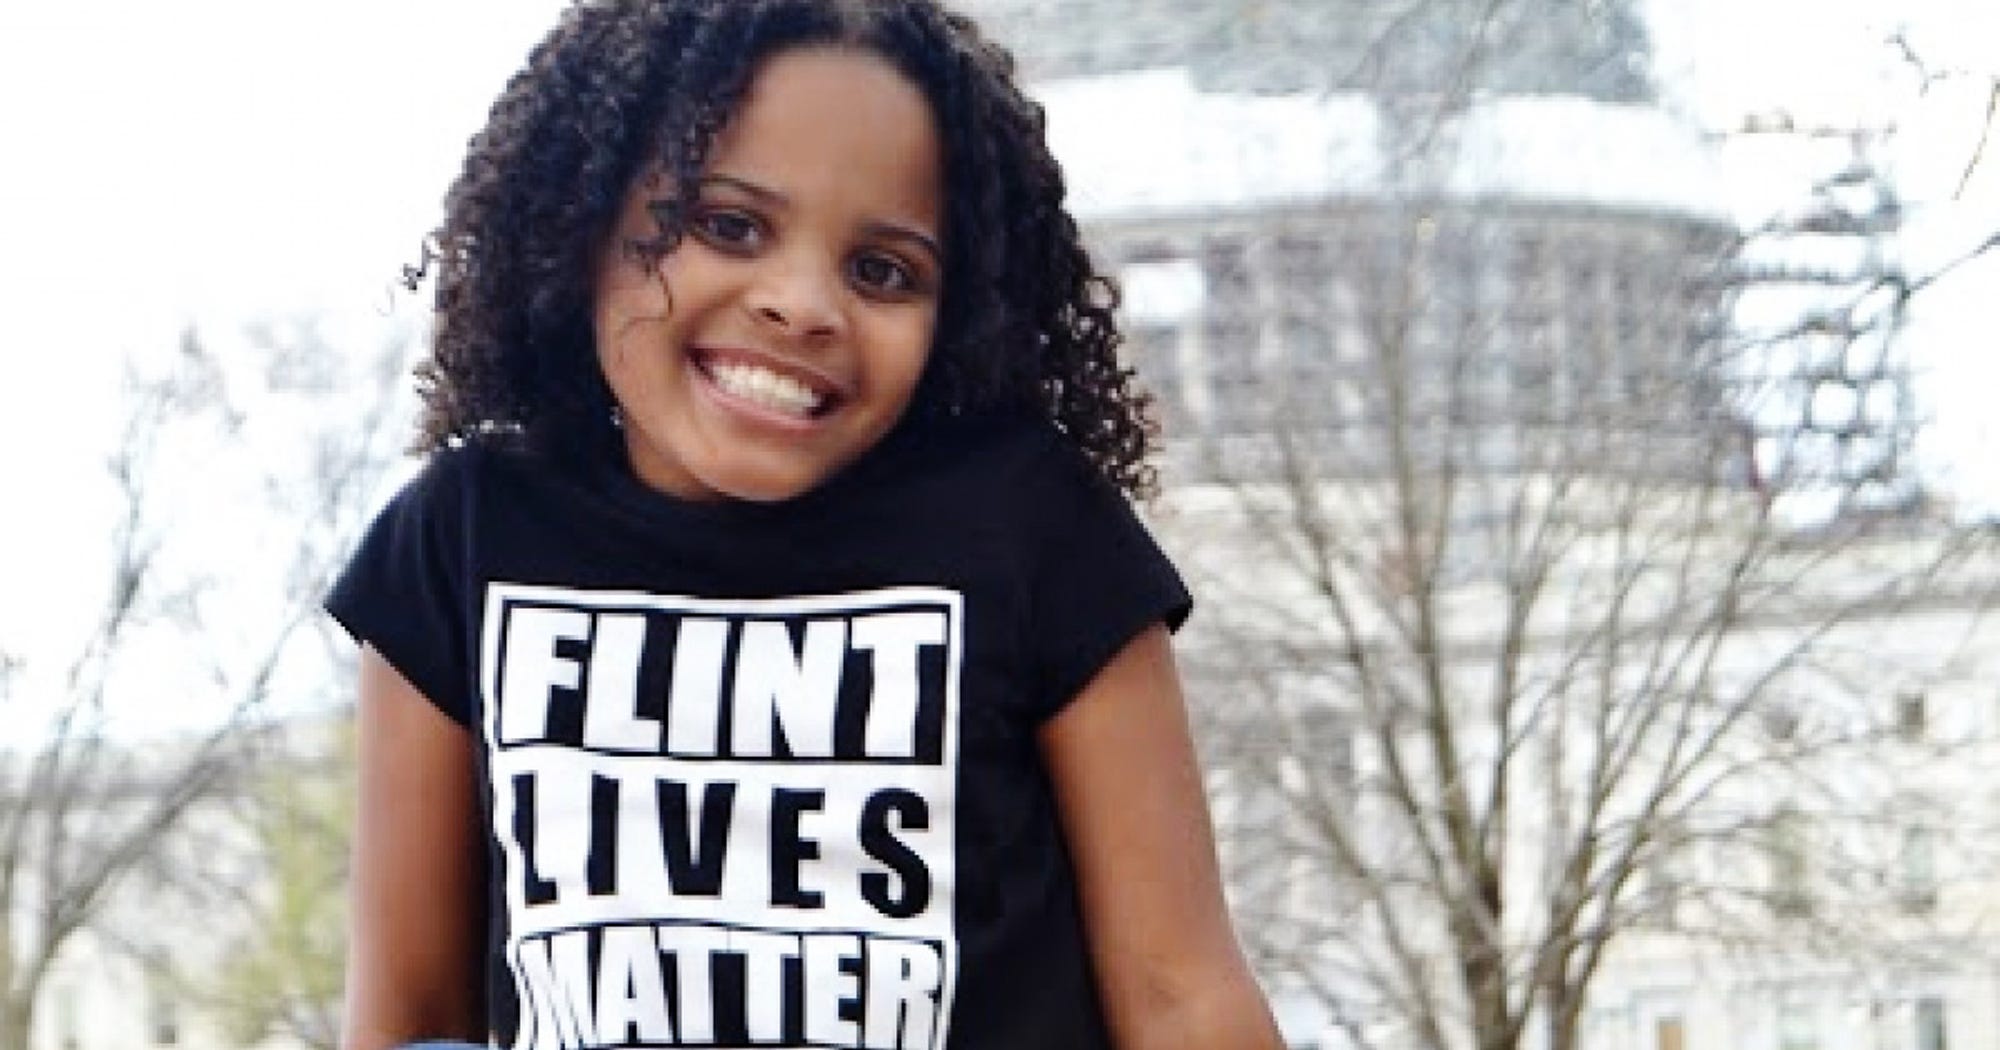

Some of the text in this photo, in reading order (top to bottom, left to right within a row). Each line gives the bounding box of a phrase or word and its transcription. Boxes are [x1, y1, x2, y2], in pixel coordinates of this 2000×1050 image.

[502, 608, 947, 757] FLINT
[511, 770, 930, 917] LIVES
[517, 926, 943, 1049] MATTER
